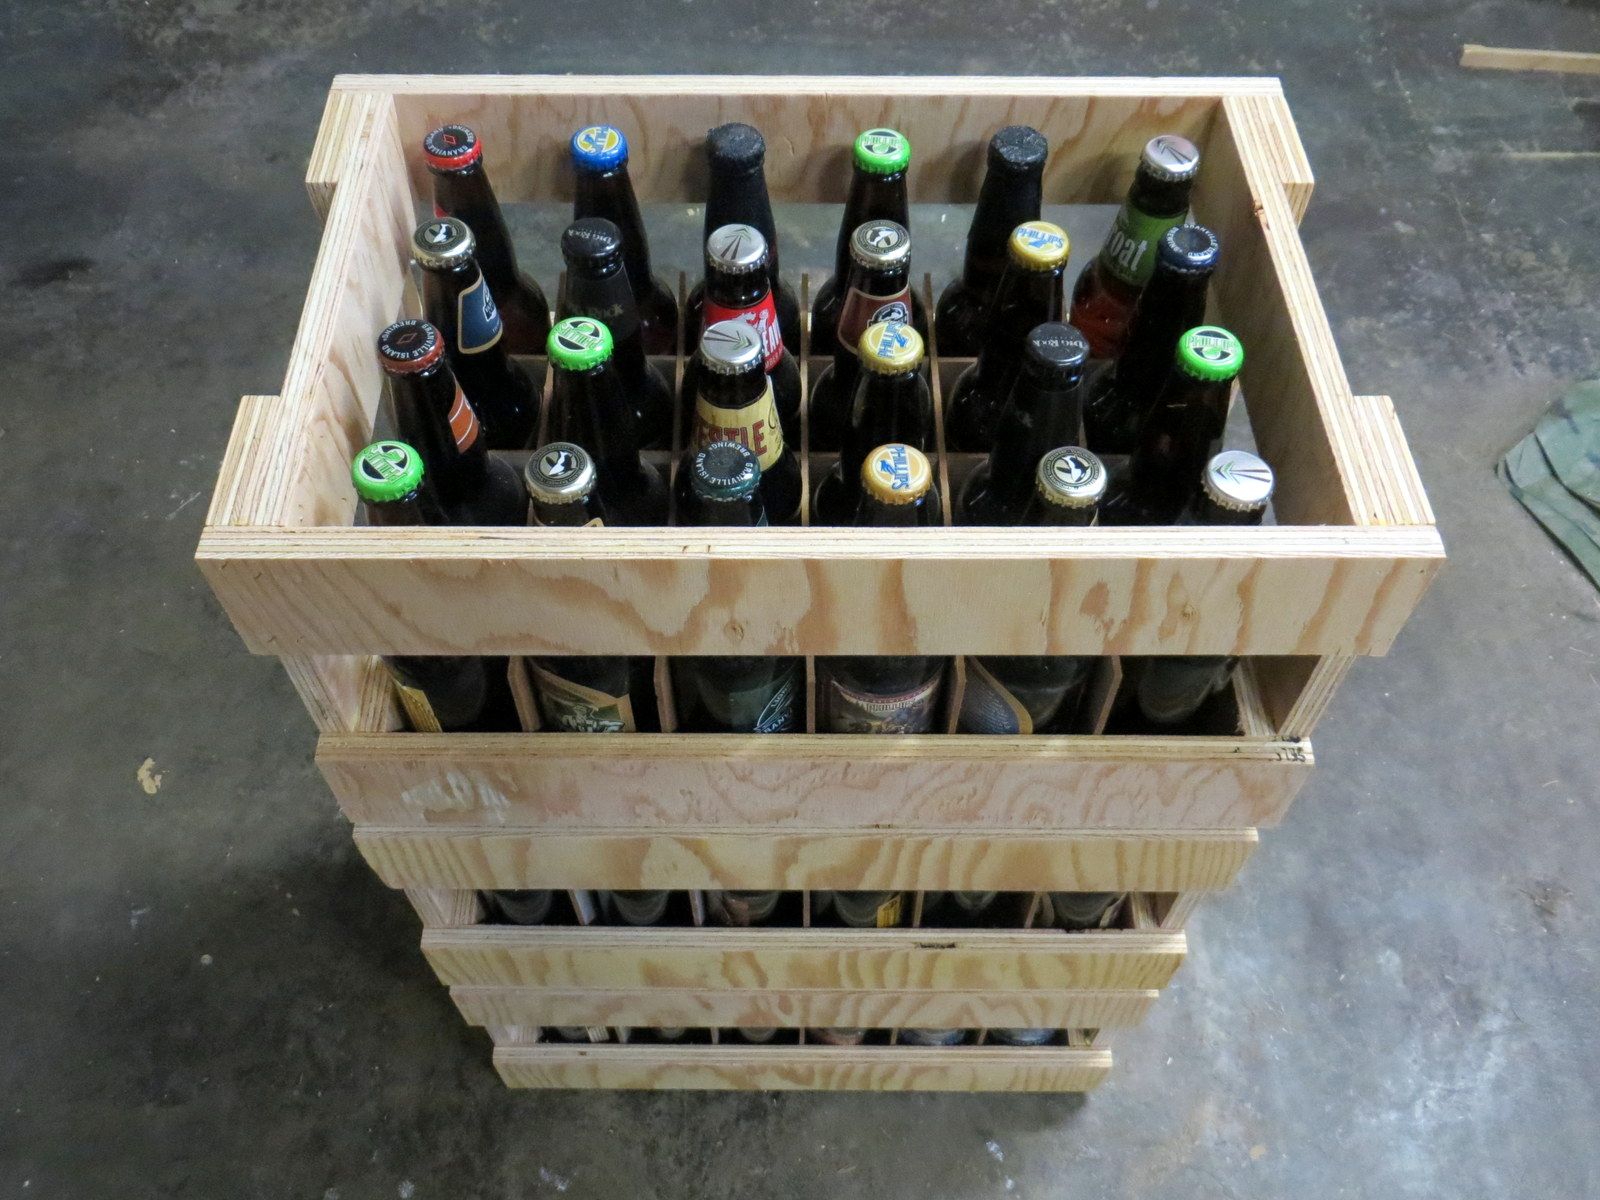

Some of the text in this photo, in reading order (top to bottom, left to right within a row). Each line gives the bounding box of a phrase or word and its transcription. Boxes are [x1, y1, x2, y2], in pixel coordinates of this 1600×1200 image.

[427, 144, 469, 157] GRANVILLE
[1016, 227, 1064, 249] PHILLIPS
[381, 319, 436, 360] GRANVILLE ISLAND BREWING
[1187, 335, 1236, 352] PHILLIPS
[363, 445, 408, 485] PHILLIPS
[695, 441, 754, 486] GRANVILLE ISLAND BREWING
